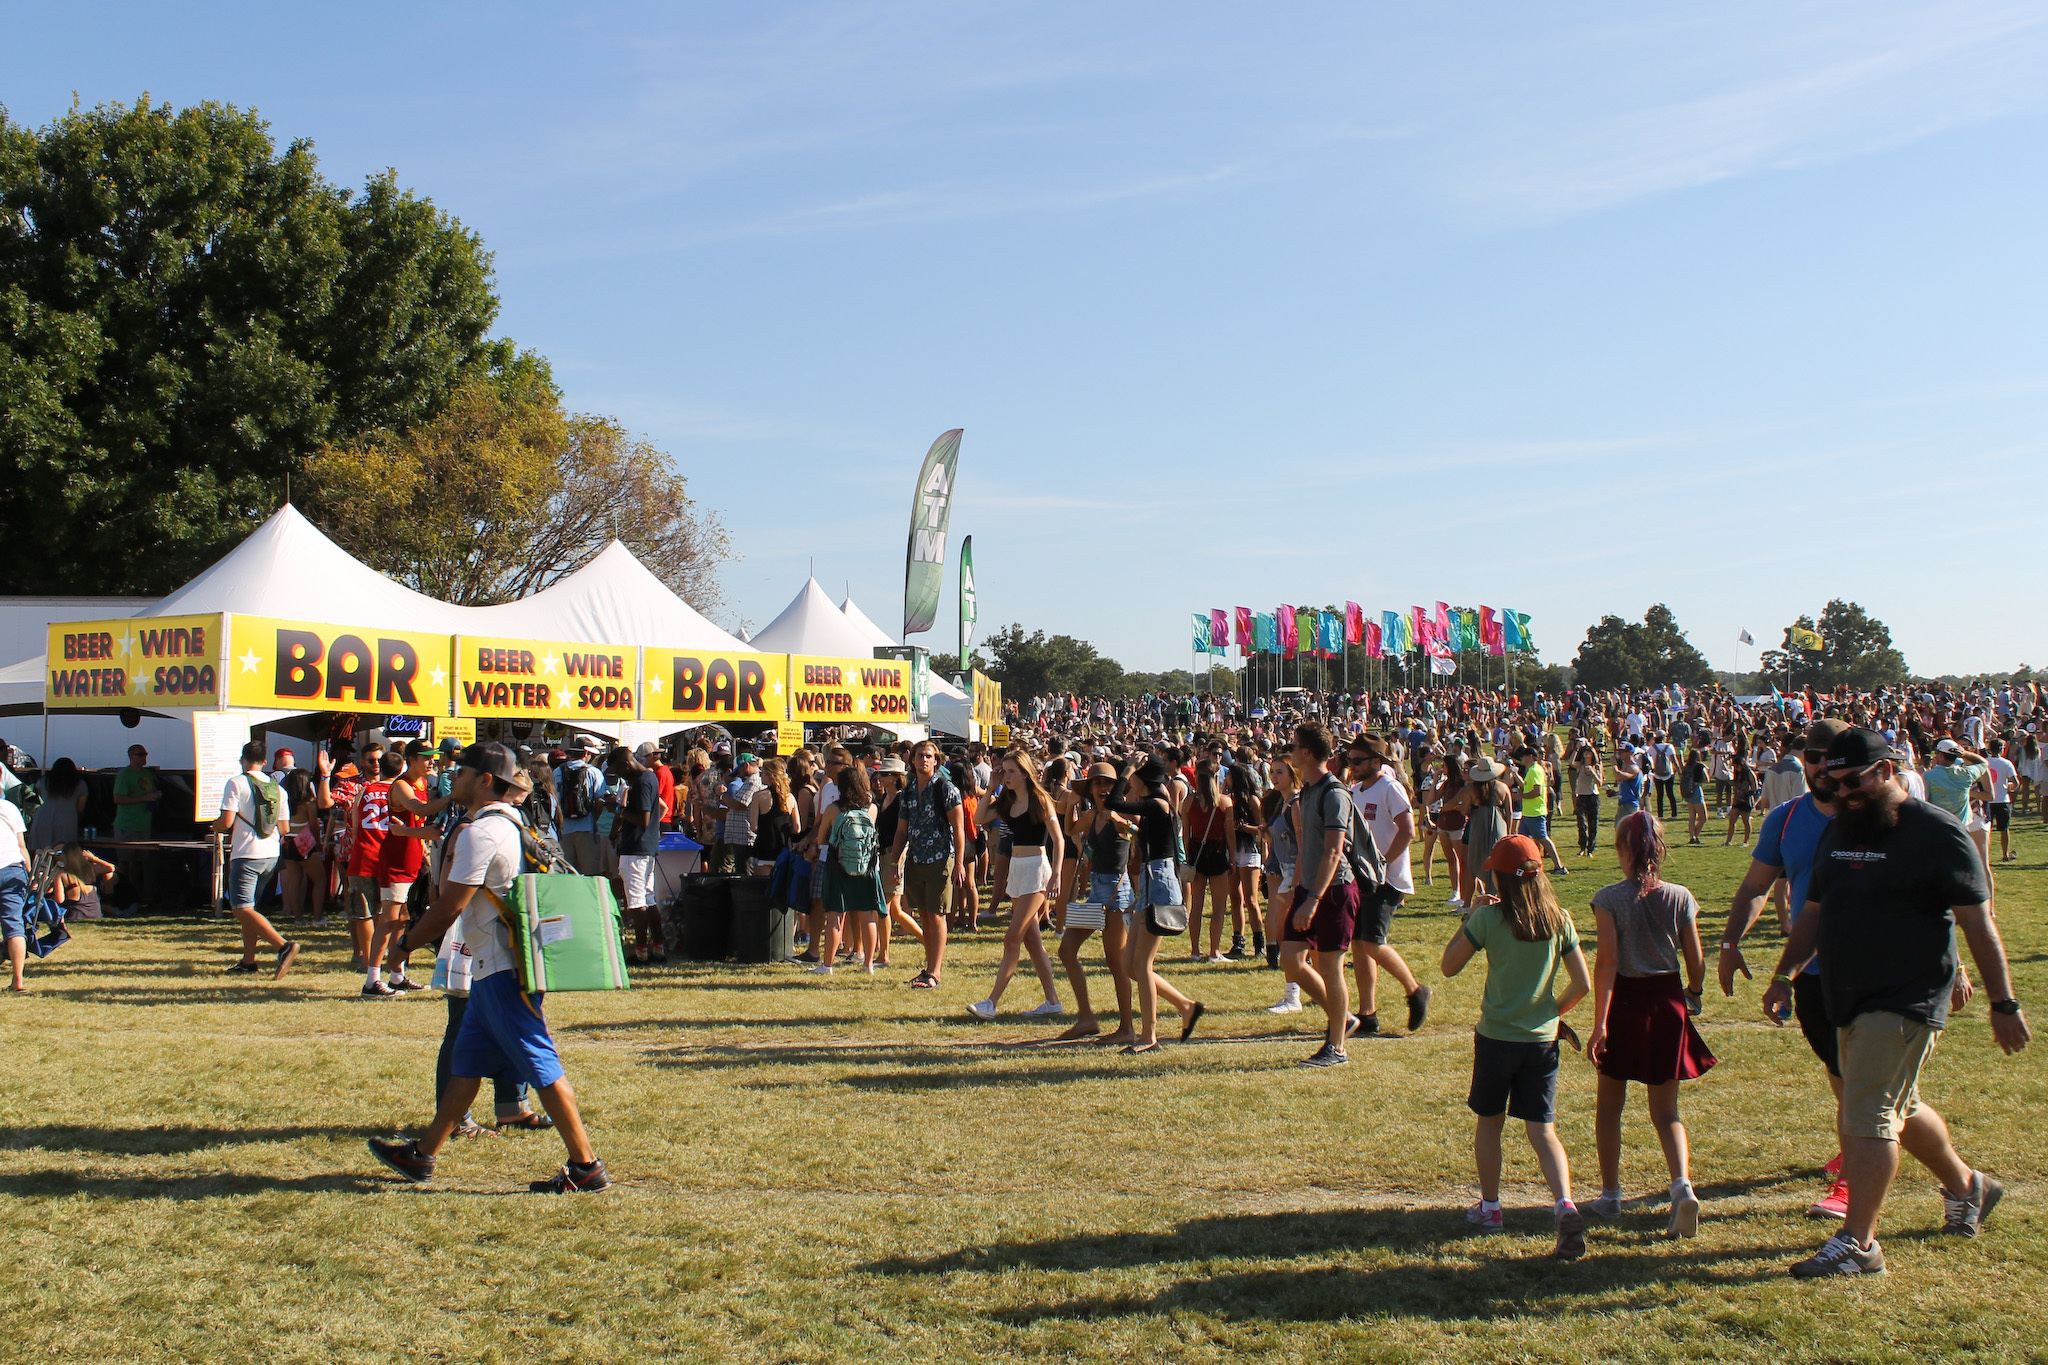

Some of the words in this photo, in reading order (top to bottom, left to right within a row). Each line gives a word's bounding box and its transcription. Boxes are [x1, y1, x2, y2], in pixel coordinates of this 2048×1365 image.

[913, 462, 949, 565] ATM
[64, 632, 114, 662] BEER
[139, 627, 205, 658] WINE
[274, 629, 420, 706] BAR
[478, 647, 536, 676] BEER
[563, 653, 624, 679] WINE
[804, 665, 843, 687] BEER
[860, 668, 901, 689] WINE
[52, 667, 127, 697] WATER
[153, 664, 217, 696] SODA
[463, 681, 551, 709] WATER
[578, 685, 633, 711] SODA
[672, 656, 767, 713] BAR
[795, 692, 853, 714] WATER
[871, 694, 908, 714] SODA
[363, 791, 388, 803] DREX
[1830, 850, 1864, 858] CROOKED
